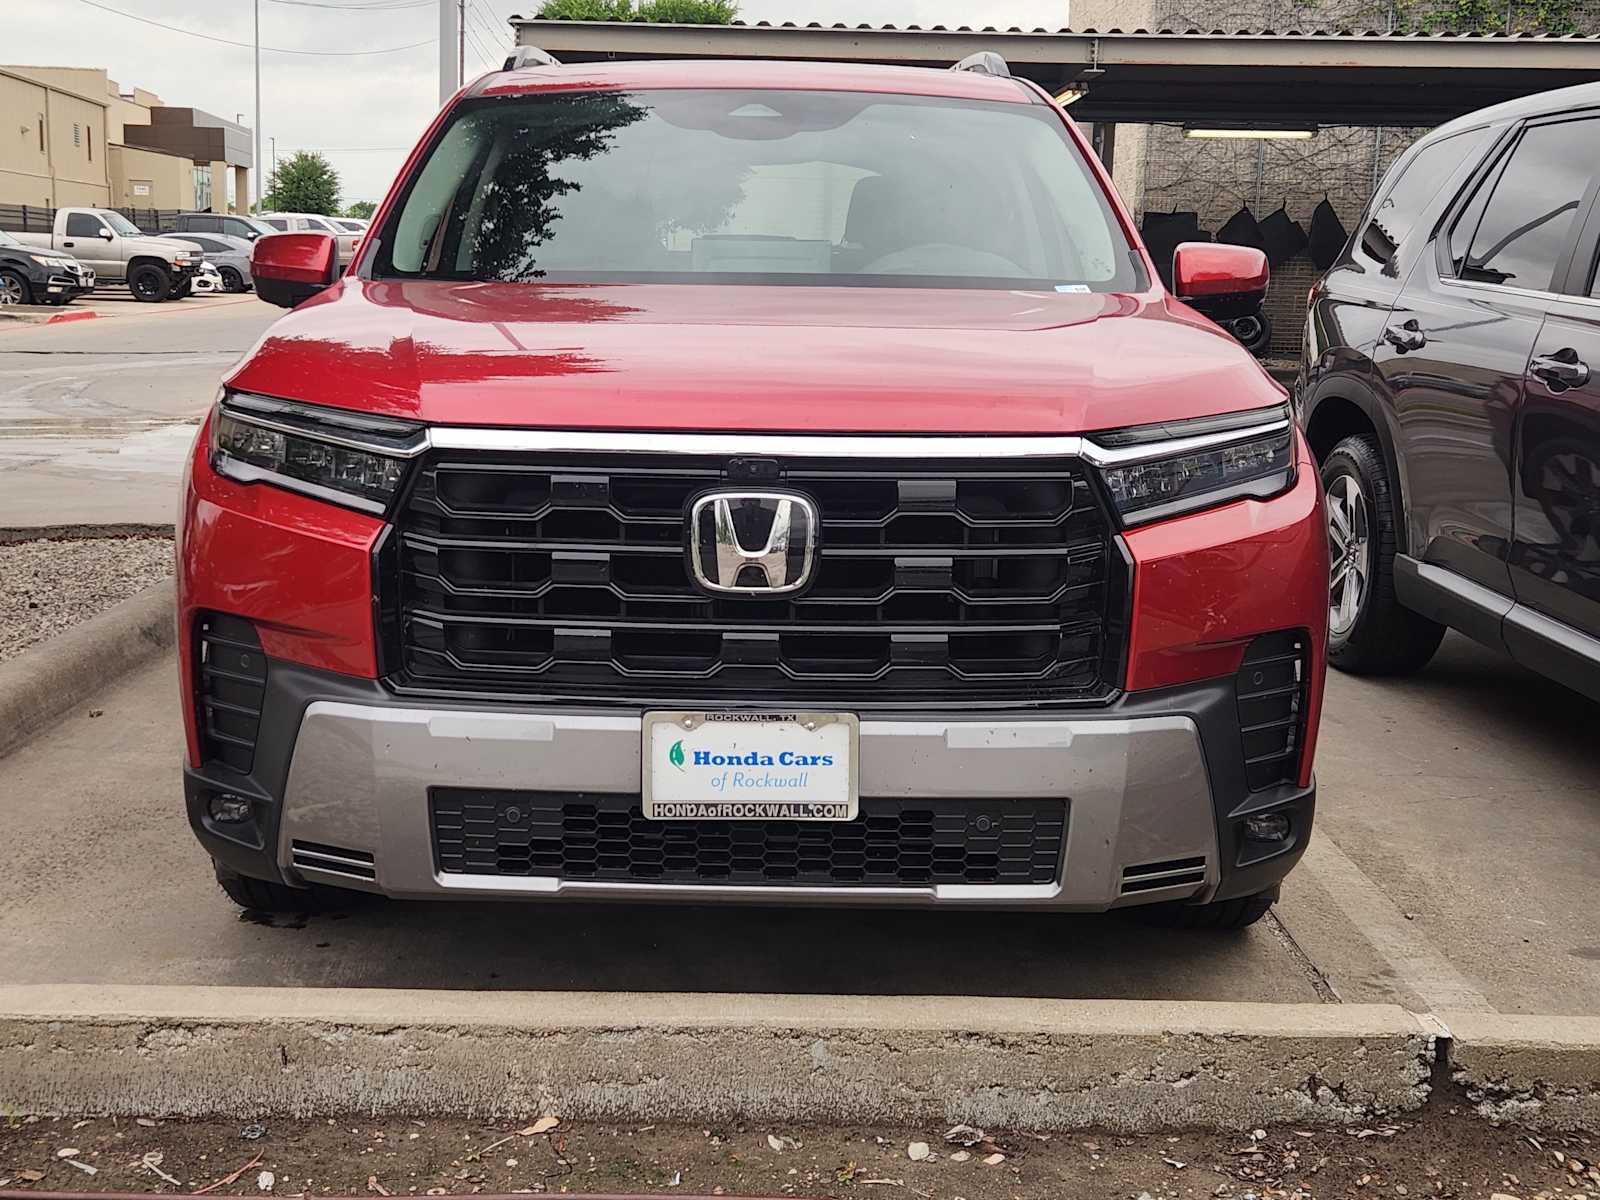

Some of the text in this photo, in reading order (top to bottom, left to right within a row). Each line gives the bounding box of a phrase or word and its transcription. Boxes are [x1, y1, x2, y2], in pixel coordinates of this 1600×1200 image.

[780, 714, 796, 722] TX
[693, 751, 833, 766] Honda Cars
[711, 772, 808, 791] of Rockwall
[654, 804, 847, 817] HONDAofROCKWALL.COM
